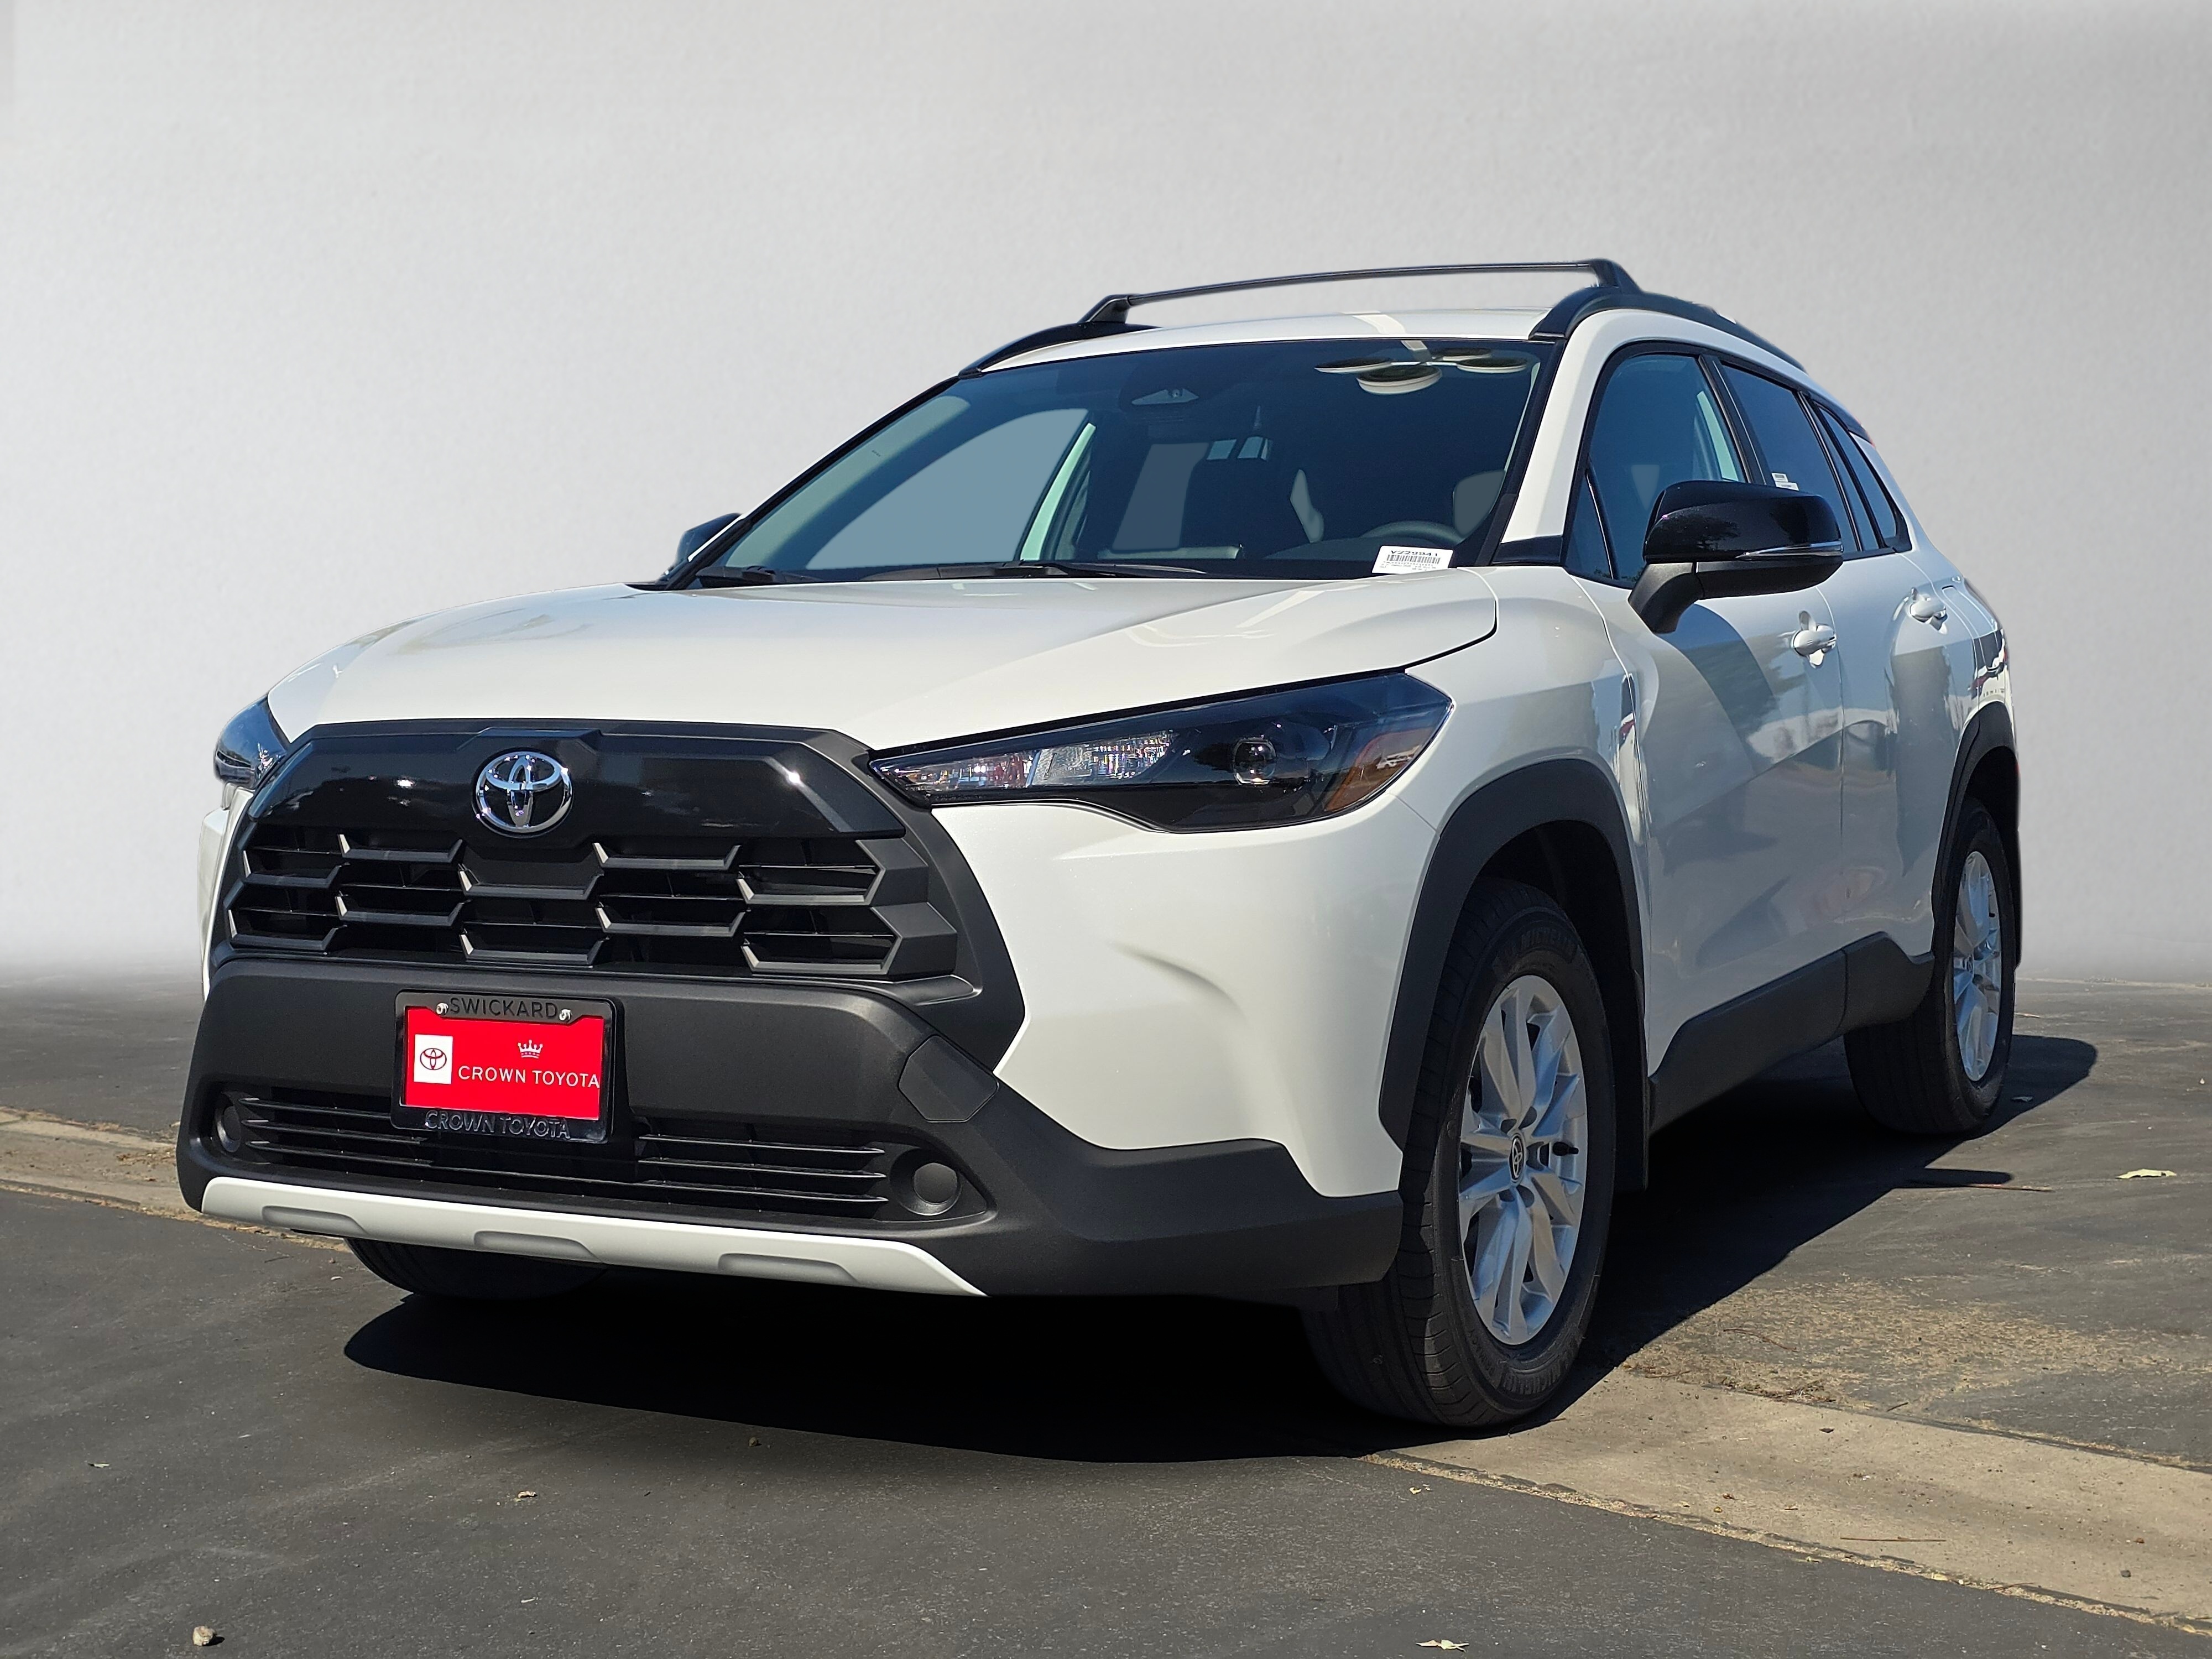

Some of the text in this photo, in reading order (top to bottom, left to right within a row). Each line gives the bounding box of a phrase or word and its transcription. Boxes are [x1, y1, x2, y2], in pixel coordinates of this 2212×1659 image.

[450, 997, 558, 1019] SWICKARD
[458, 1065, 600, 1089] CROWN TOYOTA
[425, 1109, 571, 1139] CROWN TOYOTA
